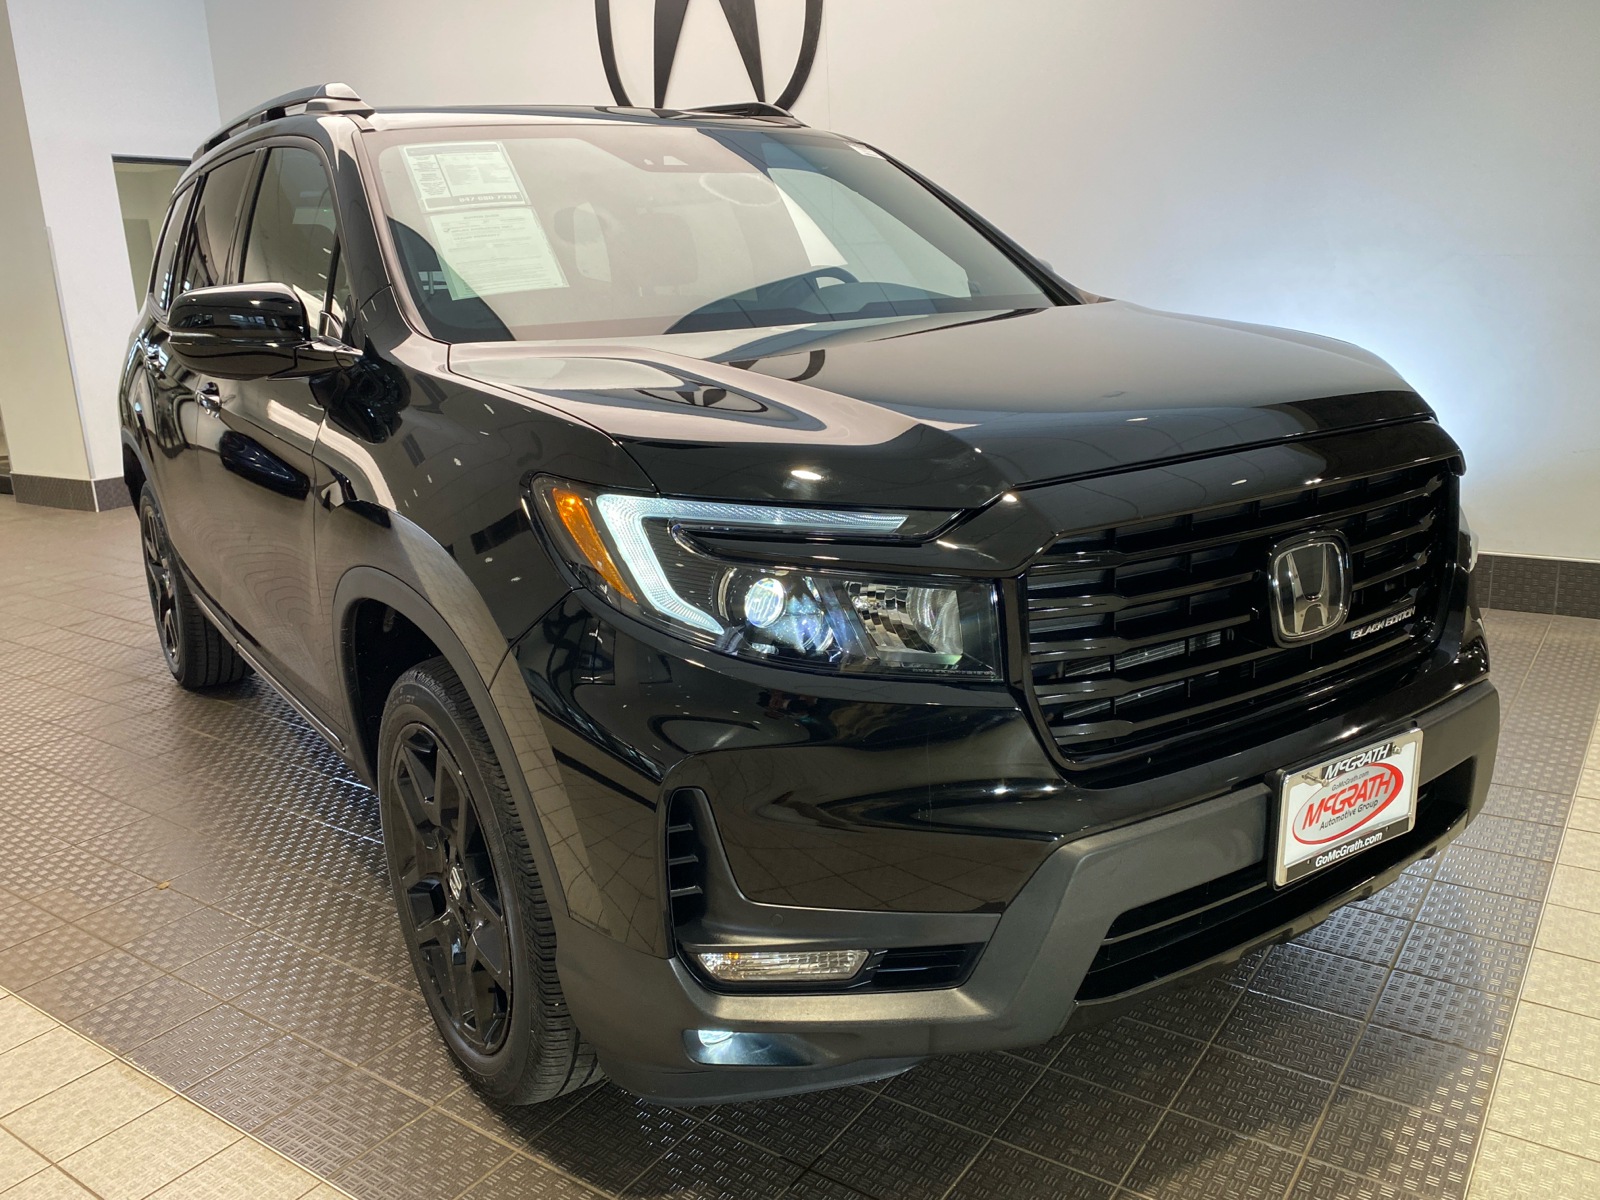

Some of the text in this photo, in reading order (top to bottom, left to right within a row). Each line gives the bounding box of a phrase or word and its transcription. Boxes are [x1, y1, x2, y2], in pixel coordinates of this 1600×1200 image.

[1351, 606, 1416, 640] BLACK EDITION
[1331, 770, 1370, 792] GoMcGrath.com
[1302, 772, 1394, 830] McGRATH
[1319, 799, 1379, 831] Automotive Group
[1315, 832, 1383, 868] GoMcGrath.com
